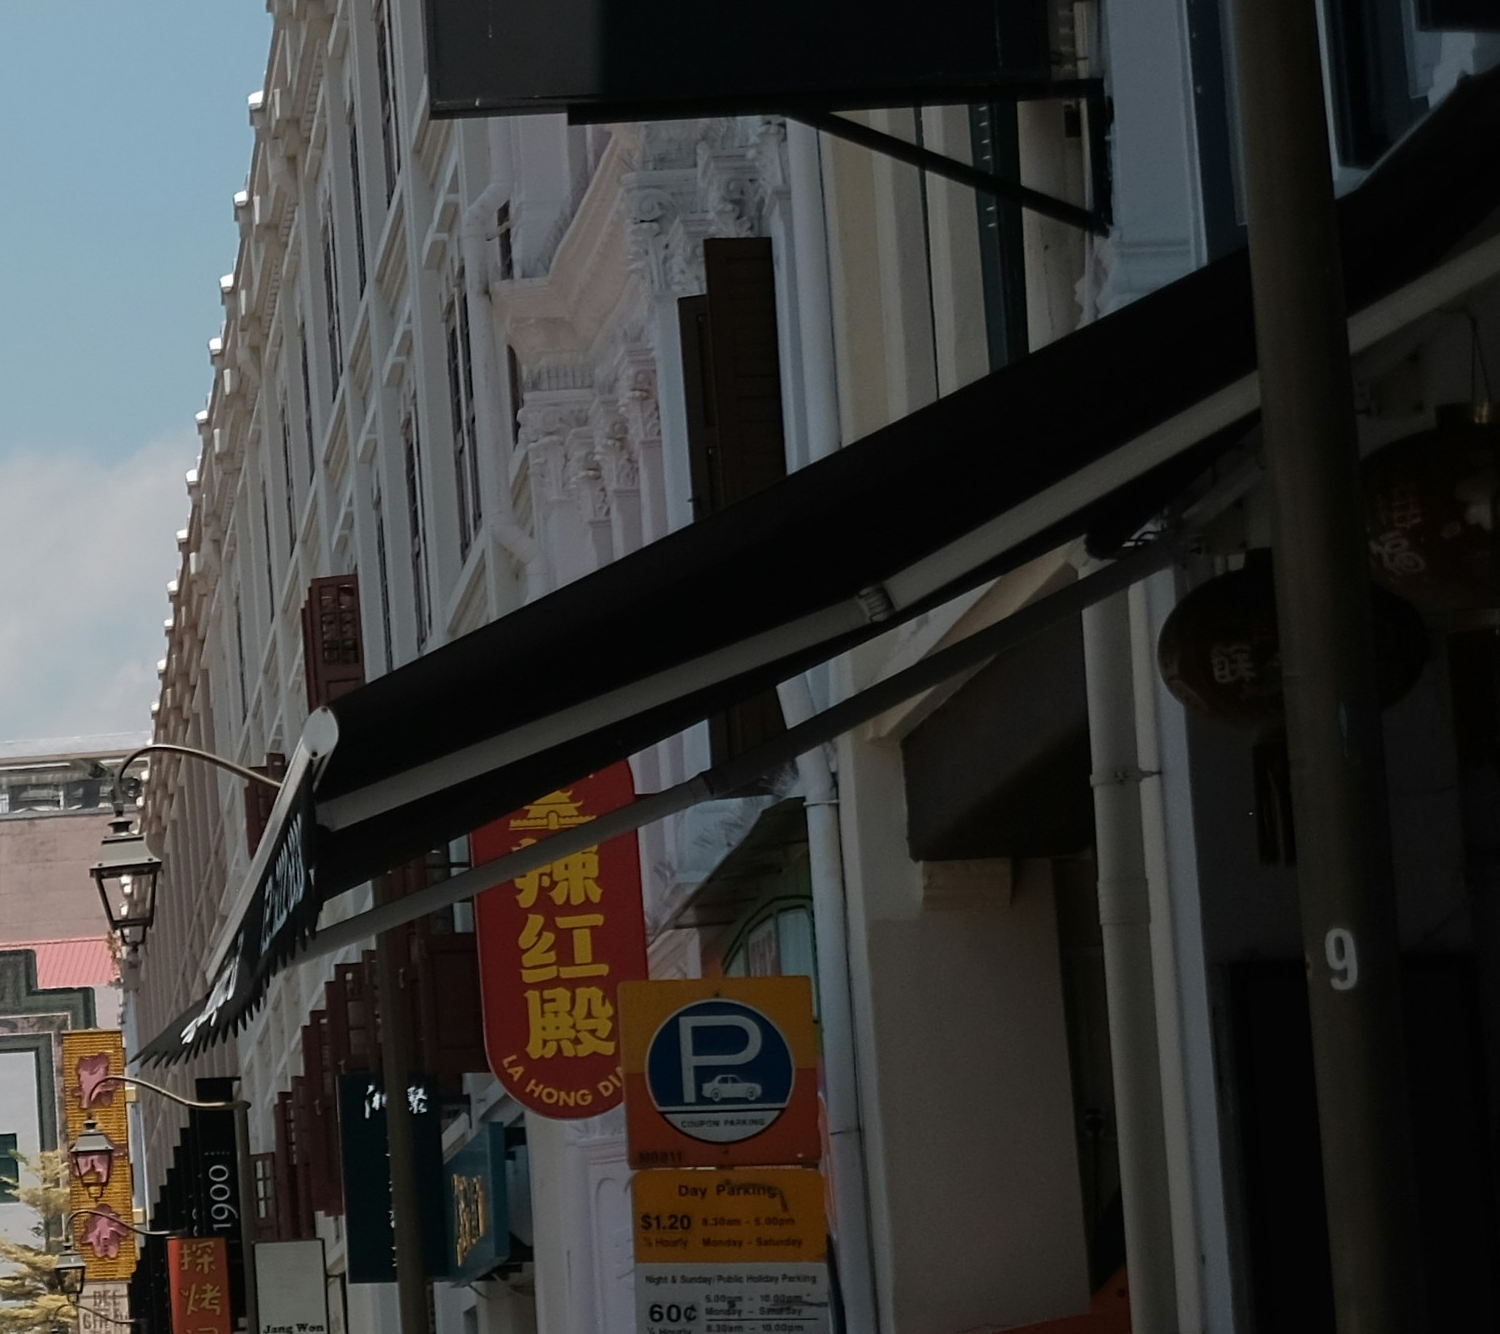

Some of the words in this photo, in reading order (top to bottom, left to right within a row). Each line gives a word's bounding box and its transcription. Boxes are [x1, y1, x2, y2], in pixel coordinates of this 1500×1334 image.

[511, 838, 616, 1060] 辣红殿
[1324, 927, 1358, 991] 9
[679, 1014, 763, 1104] P
[502, 1054, 527, 1082] LA
[525, 1078, 594, 1107] HONG
[681, 1120, 720, 1128] COUPON
[724, 1118, 766, 1128] PARKING
[208, 1163, 239, 1232] 1900
[678, 1185, 707, 1199] Day
[716, 1183, 781, 1199] Parking
[641, 1214, 692, 1231] $1.20
[655, 1237, 688, 1249] Hourly
[702, 1237, 744, 1248] Monday
[756, 1236, 803, 1248] Saturday
[646, 1275, 668, 1286] Night
[746, 1274, 780, 1285] Holiday
[781, 1273, 817, 1285] Parking
[649, 1304, 697, 1323] 60¢
[296, 1322, 325, 1334] Won
